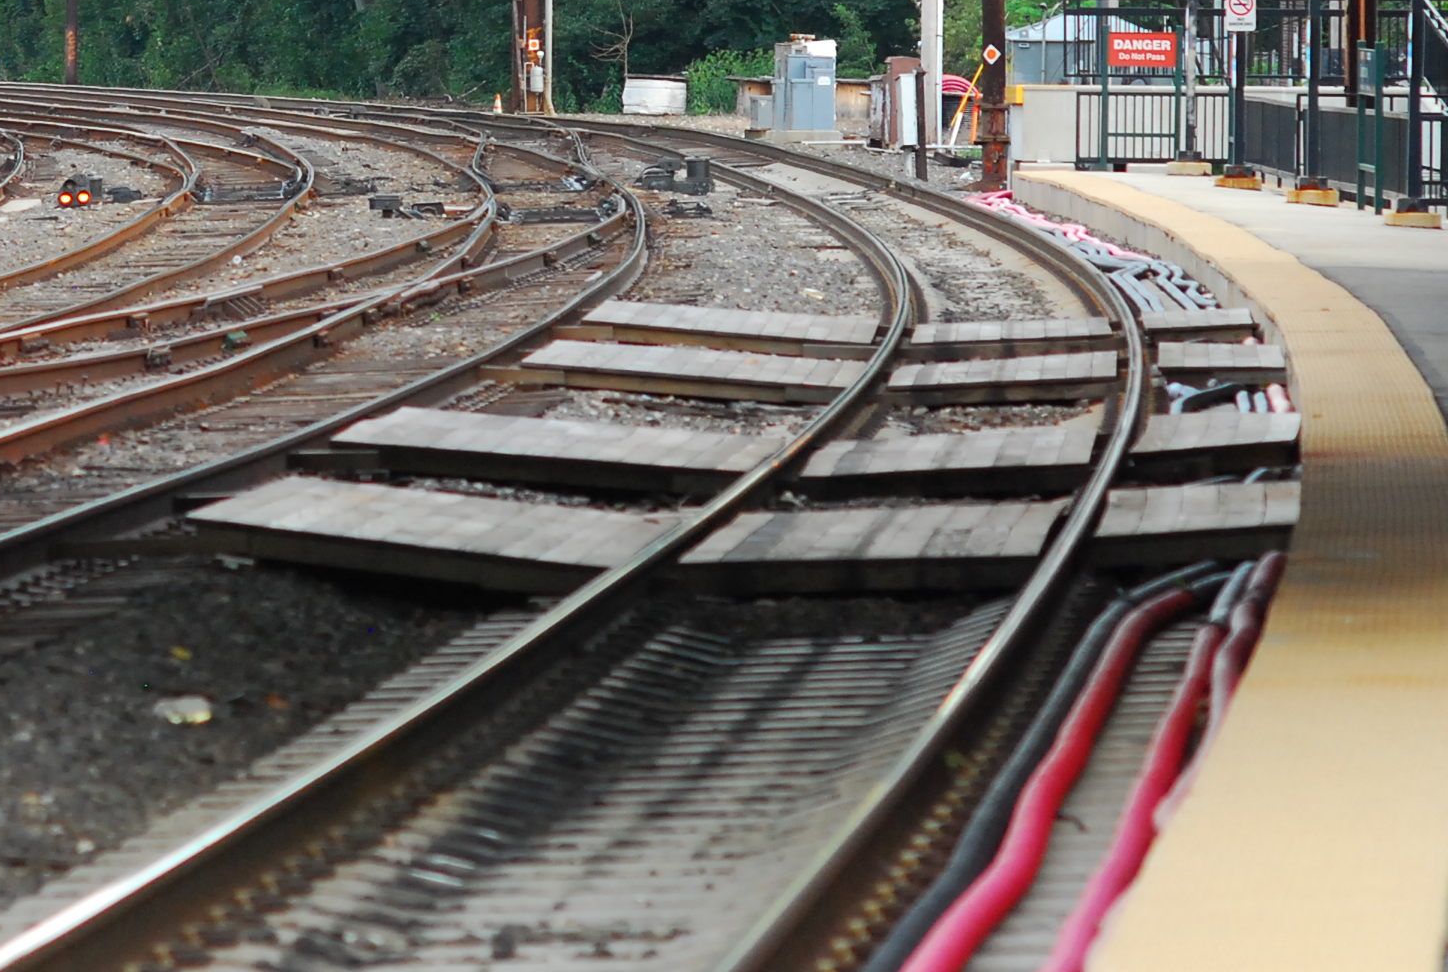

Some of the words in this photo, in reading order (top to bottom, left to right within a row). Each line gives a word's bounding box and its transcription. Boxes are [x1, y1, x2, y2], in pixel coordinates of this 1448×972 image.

[1113, 39, 1171, 51] DANGER
[1118, 52, 1130, 60] Do
[1131, 52, 1145, 60] Not
[1146, 53, 1166, 61] Pass
